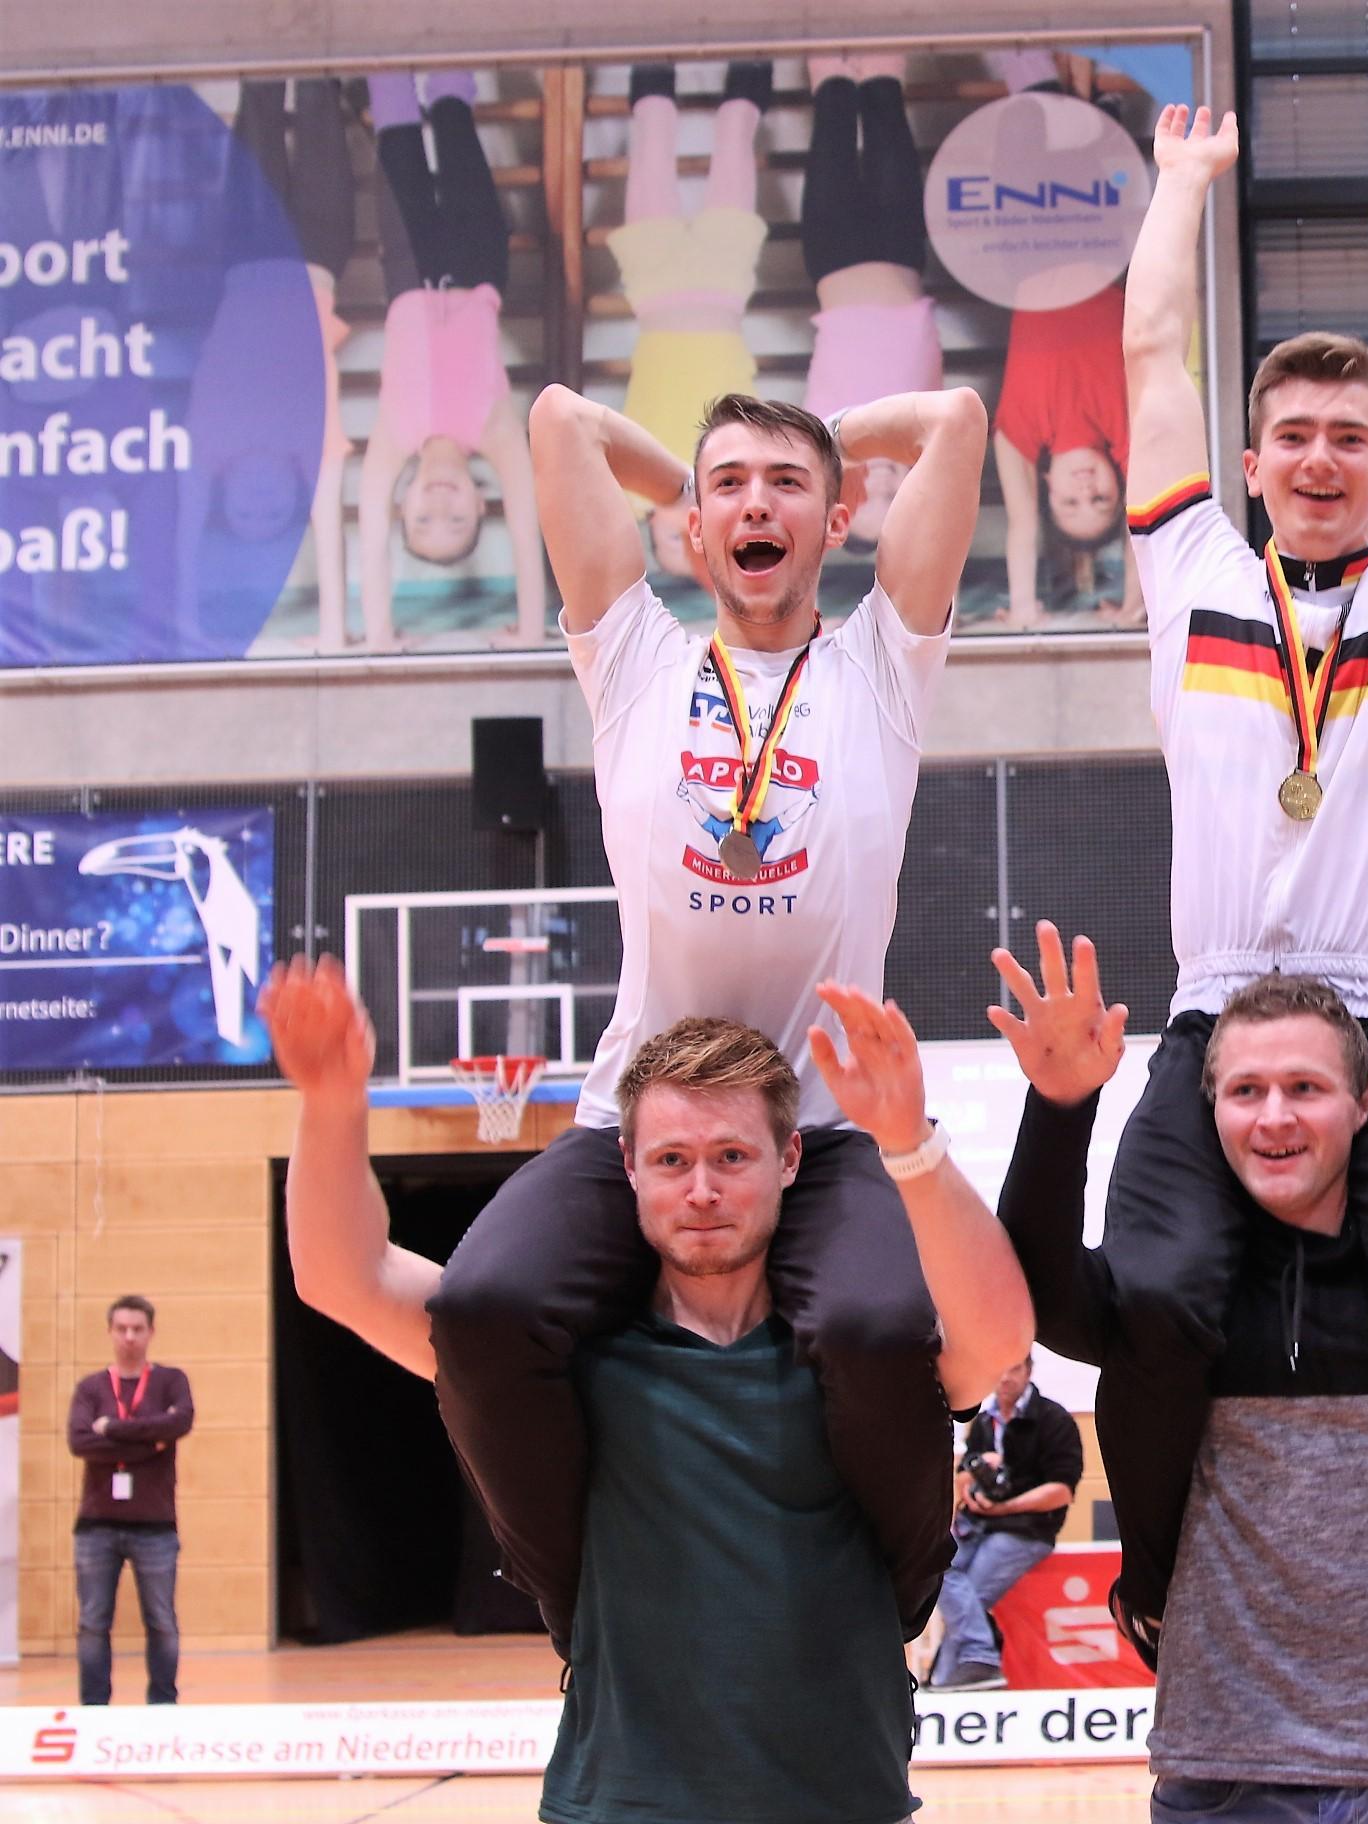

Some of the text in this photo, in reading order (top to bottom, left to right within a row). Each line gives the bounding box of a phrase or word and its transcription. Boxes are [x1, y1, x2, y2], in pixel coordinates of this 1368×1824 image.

[0, 123, 107, 147] .ENNI.DE
[0, 316, 155, 382] acht
[0, 408, 191, 477] nfach
[0, 830, 55, 866] RE
[689, 891, 797, 915] SPORT
[1041, 1698, 1148, 1742] der
[93, 1731, 538, 1767] Sparkasse am Niederrhein
